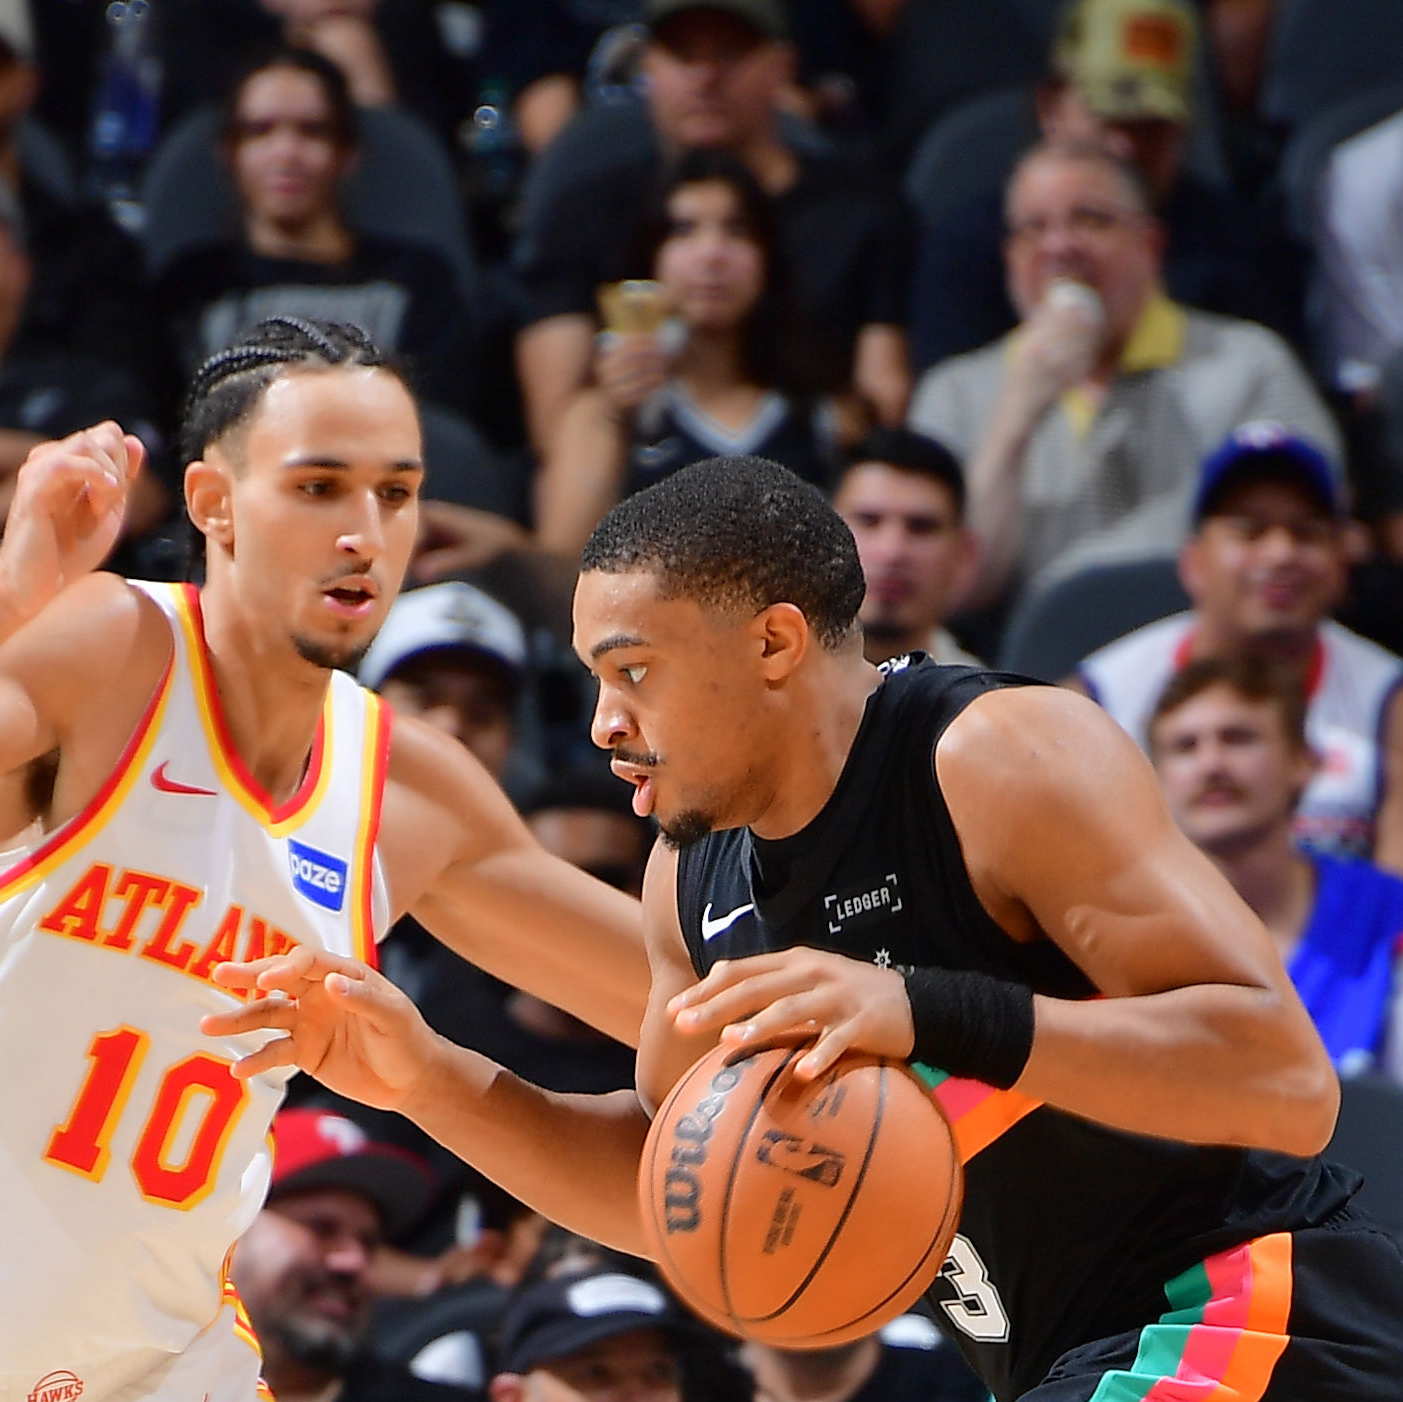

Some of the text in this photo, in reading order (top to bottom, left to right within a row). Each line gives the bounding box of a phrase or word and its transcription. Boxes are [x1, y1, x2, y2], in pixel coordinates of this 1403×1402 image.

[37, 860, 303, 1001] ATLAN
[836, 886, 891, 921] LEDGER
[42, 1023, 250, 1212] 10
[664, 1057, 760, 1235] Wilso
[936, 1232, 1011, 1342] 3
